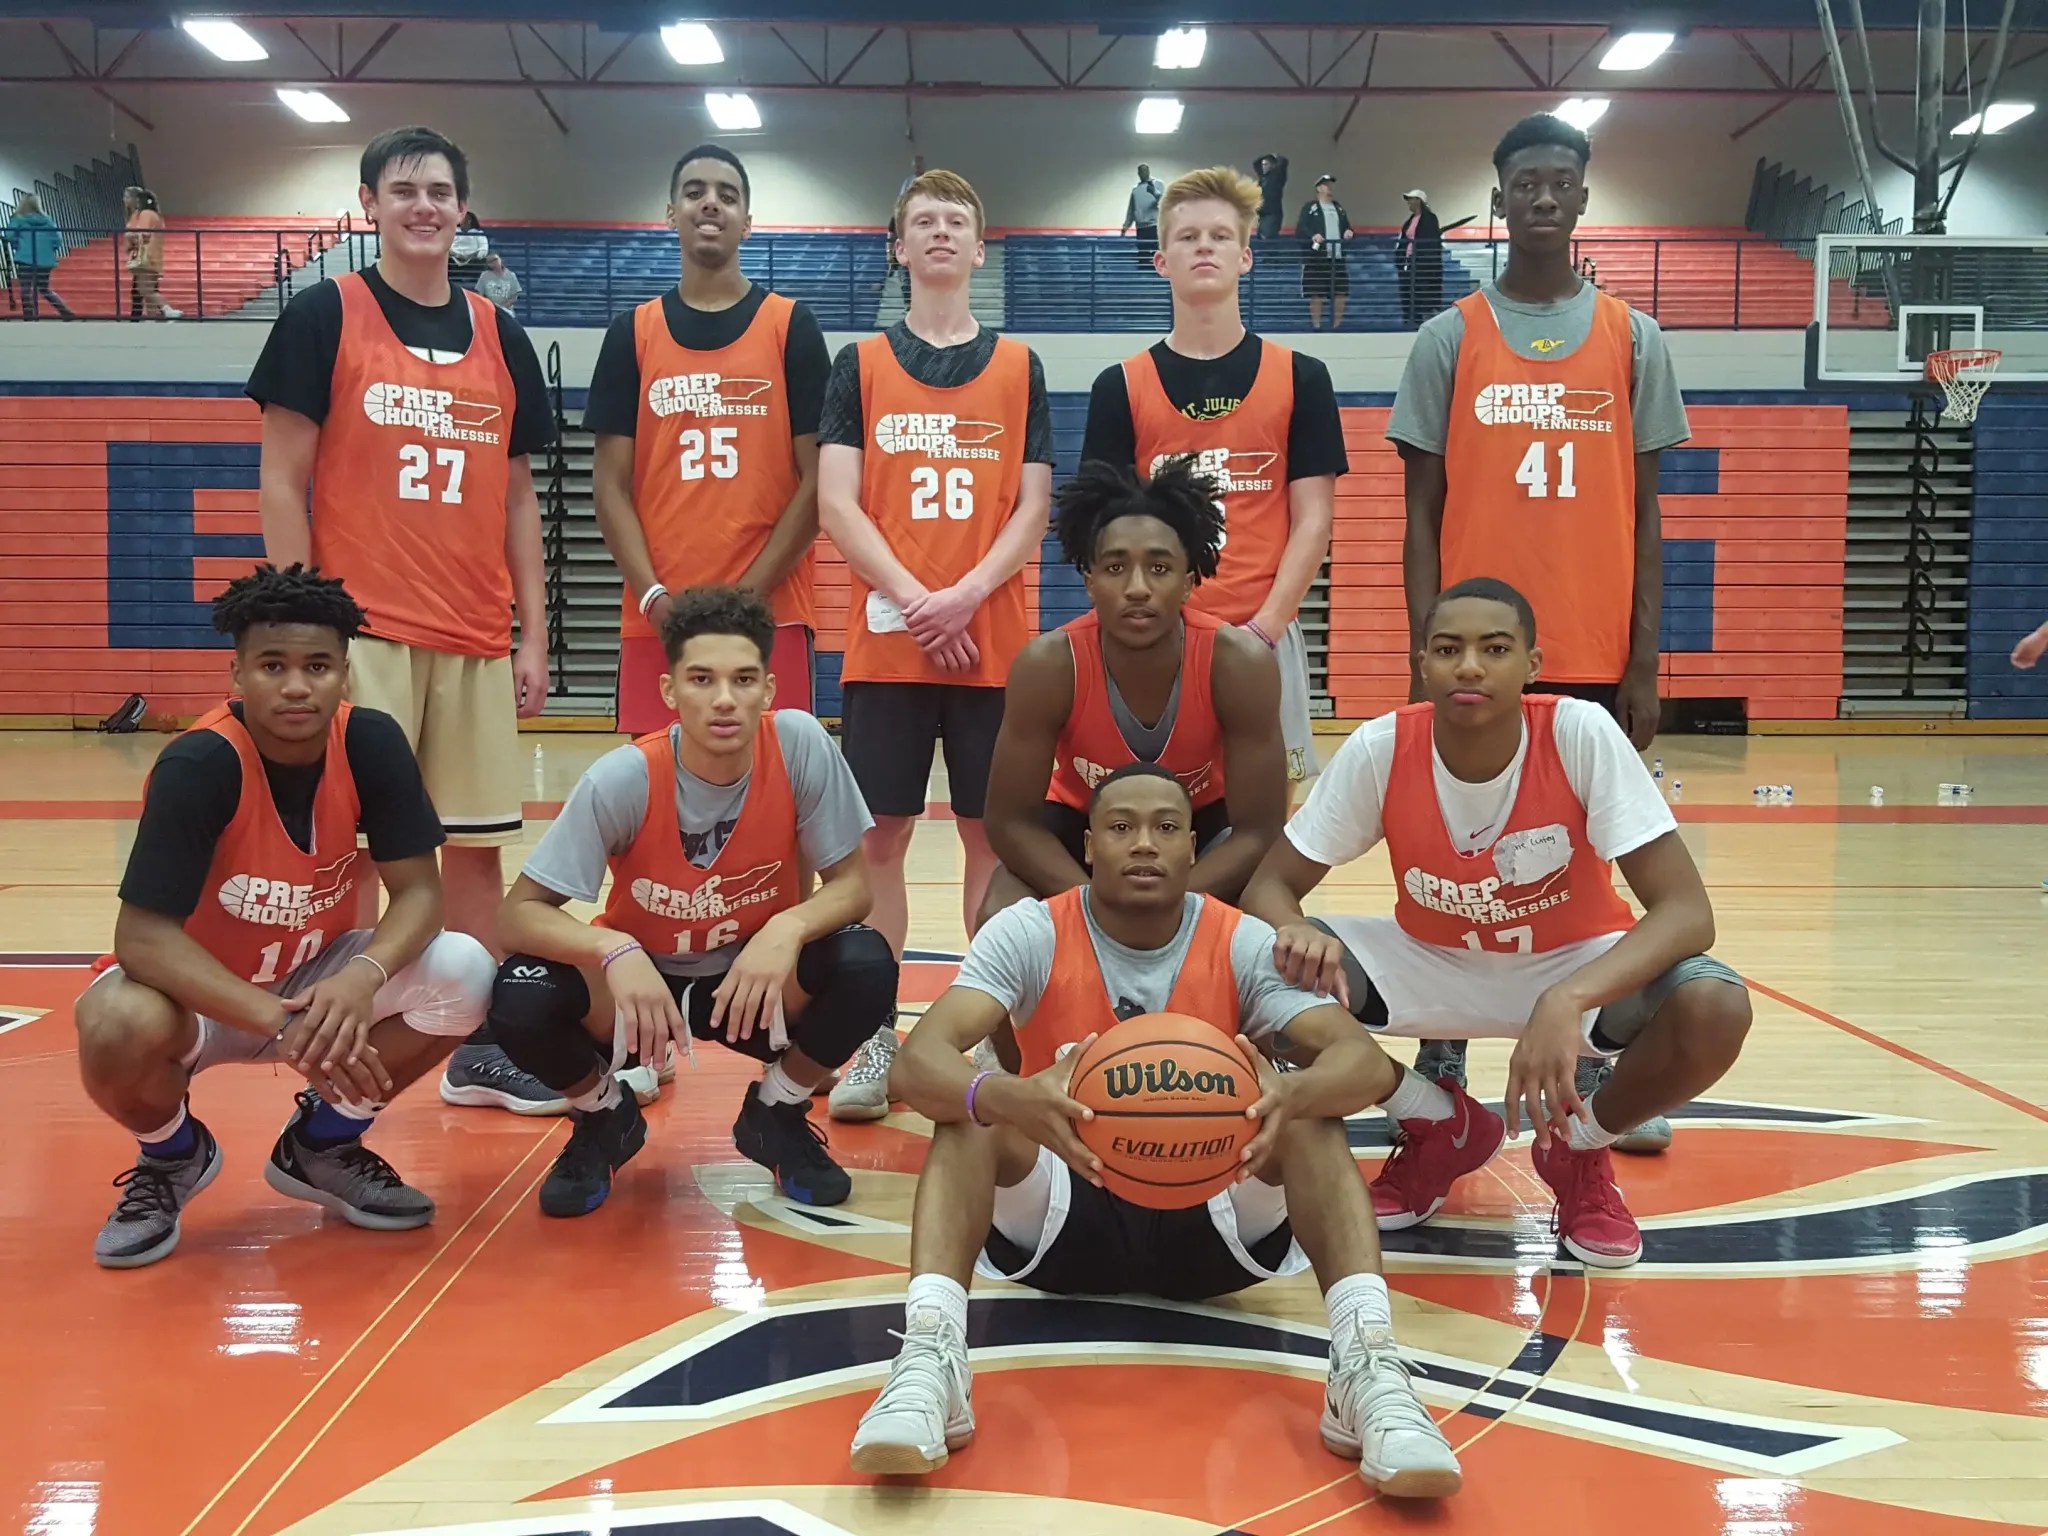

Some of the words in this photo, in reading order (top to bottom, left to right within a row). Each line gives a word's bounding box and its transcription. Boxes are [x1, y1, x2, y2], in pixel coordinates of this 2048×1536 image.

[384, 383, 453, 412] PREP
[661, 372, 721, 398] PREP
[1494, 383, 1565, 405] PREP
[664, 393, 721, 415] HOOPS
[695, 405, 768, 417] TENNESSEE
[1494, 405, 1565, 423] HOOPS
[385, 406, 454, 430] HOOPS
[893, 413, 956, 434] PREP
[1533, 419, 1612, 432] TENNESSEE
[423, 425, 499, 444] TENNESSEE
[895, 434, 956, 452] HOOPS
[679, 427, 738, 480] 25
[927, 448, 1000, 460] TENNESSEE
[399, 444, 465, 504] 27
[1515, 441, 1576, 497] 41
[911, 467, 973, 519] 26
[650, 875, 722, 908] PREP
[1422, 872, 1500, 905] PREP
[649, 893, 724, 919] HOOPS
[692, 887, 778, 922] TENNESSEE
[1425, 894, 1507, 920] HOOPS
[1472, 890, 1570, 924] TENNESSEE
[671, 919, 740, 956] 16
[1461, 925, 1533, 953] 17
[251, 928, 324, 984] 10
[1104, 1058, 1236, 1099] Wilson
[1112, 1134, 1235, 1159] EVOLUTION
